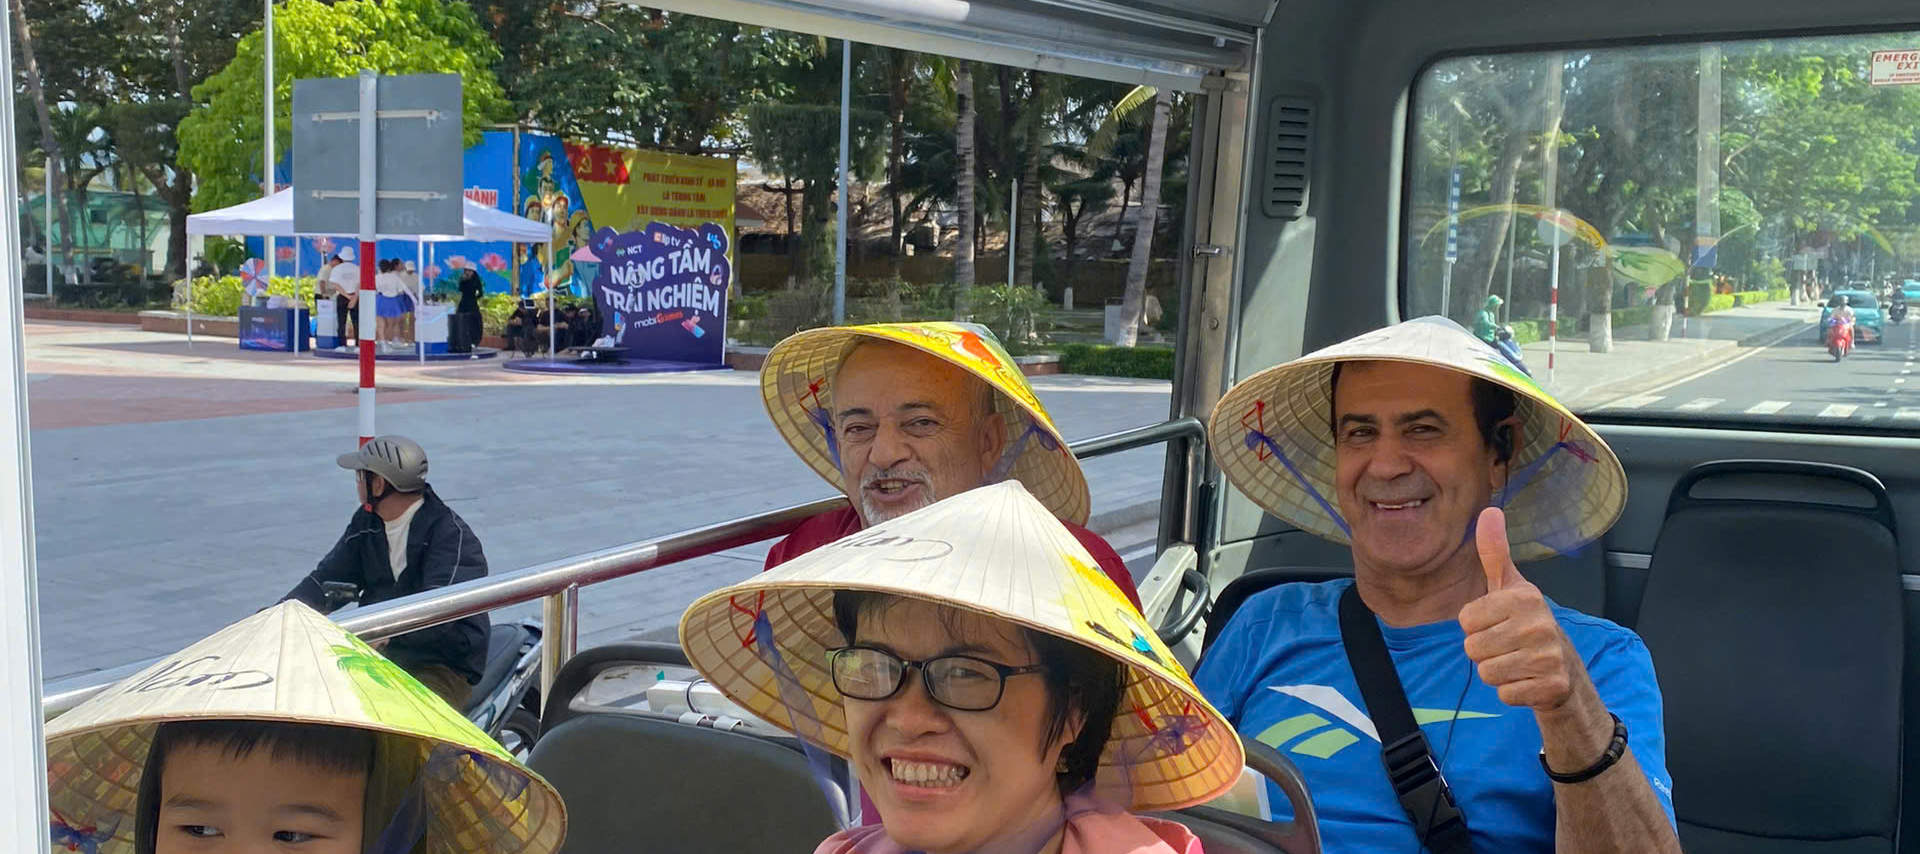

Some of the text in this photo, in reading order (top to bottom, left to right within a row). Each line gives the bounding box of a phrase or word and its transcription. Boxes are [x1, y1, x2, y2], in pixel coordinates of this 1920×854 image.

[1875, 53, 1920, 62] EMERG
[610, 257, 665, 286] NÂNG
[669, 239, 711, 276] TẦM
[627, 245, 642, 255] NCT
[601, 276, 720, 318] TRẢI NGHIỆM
